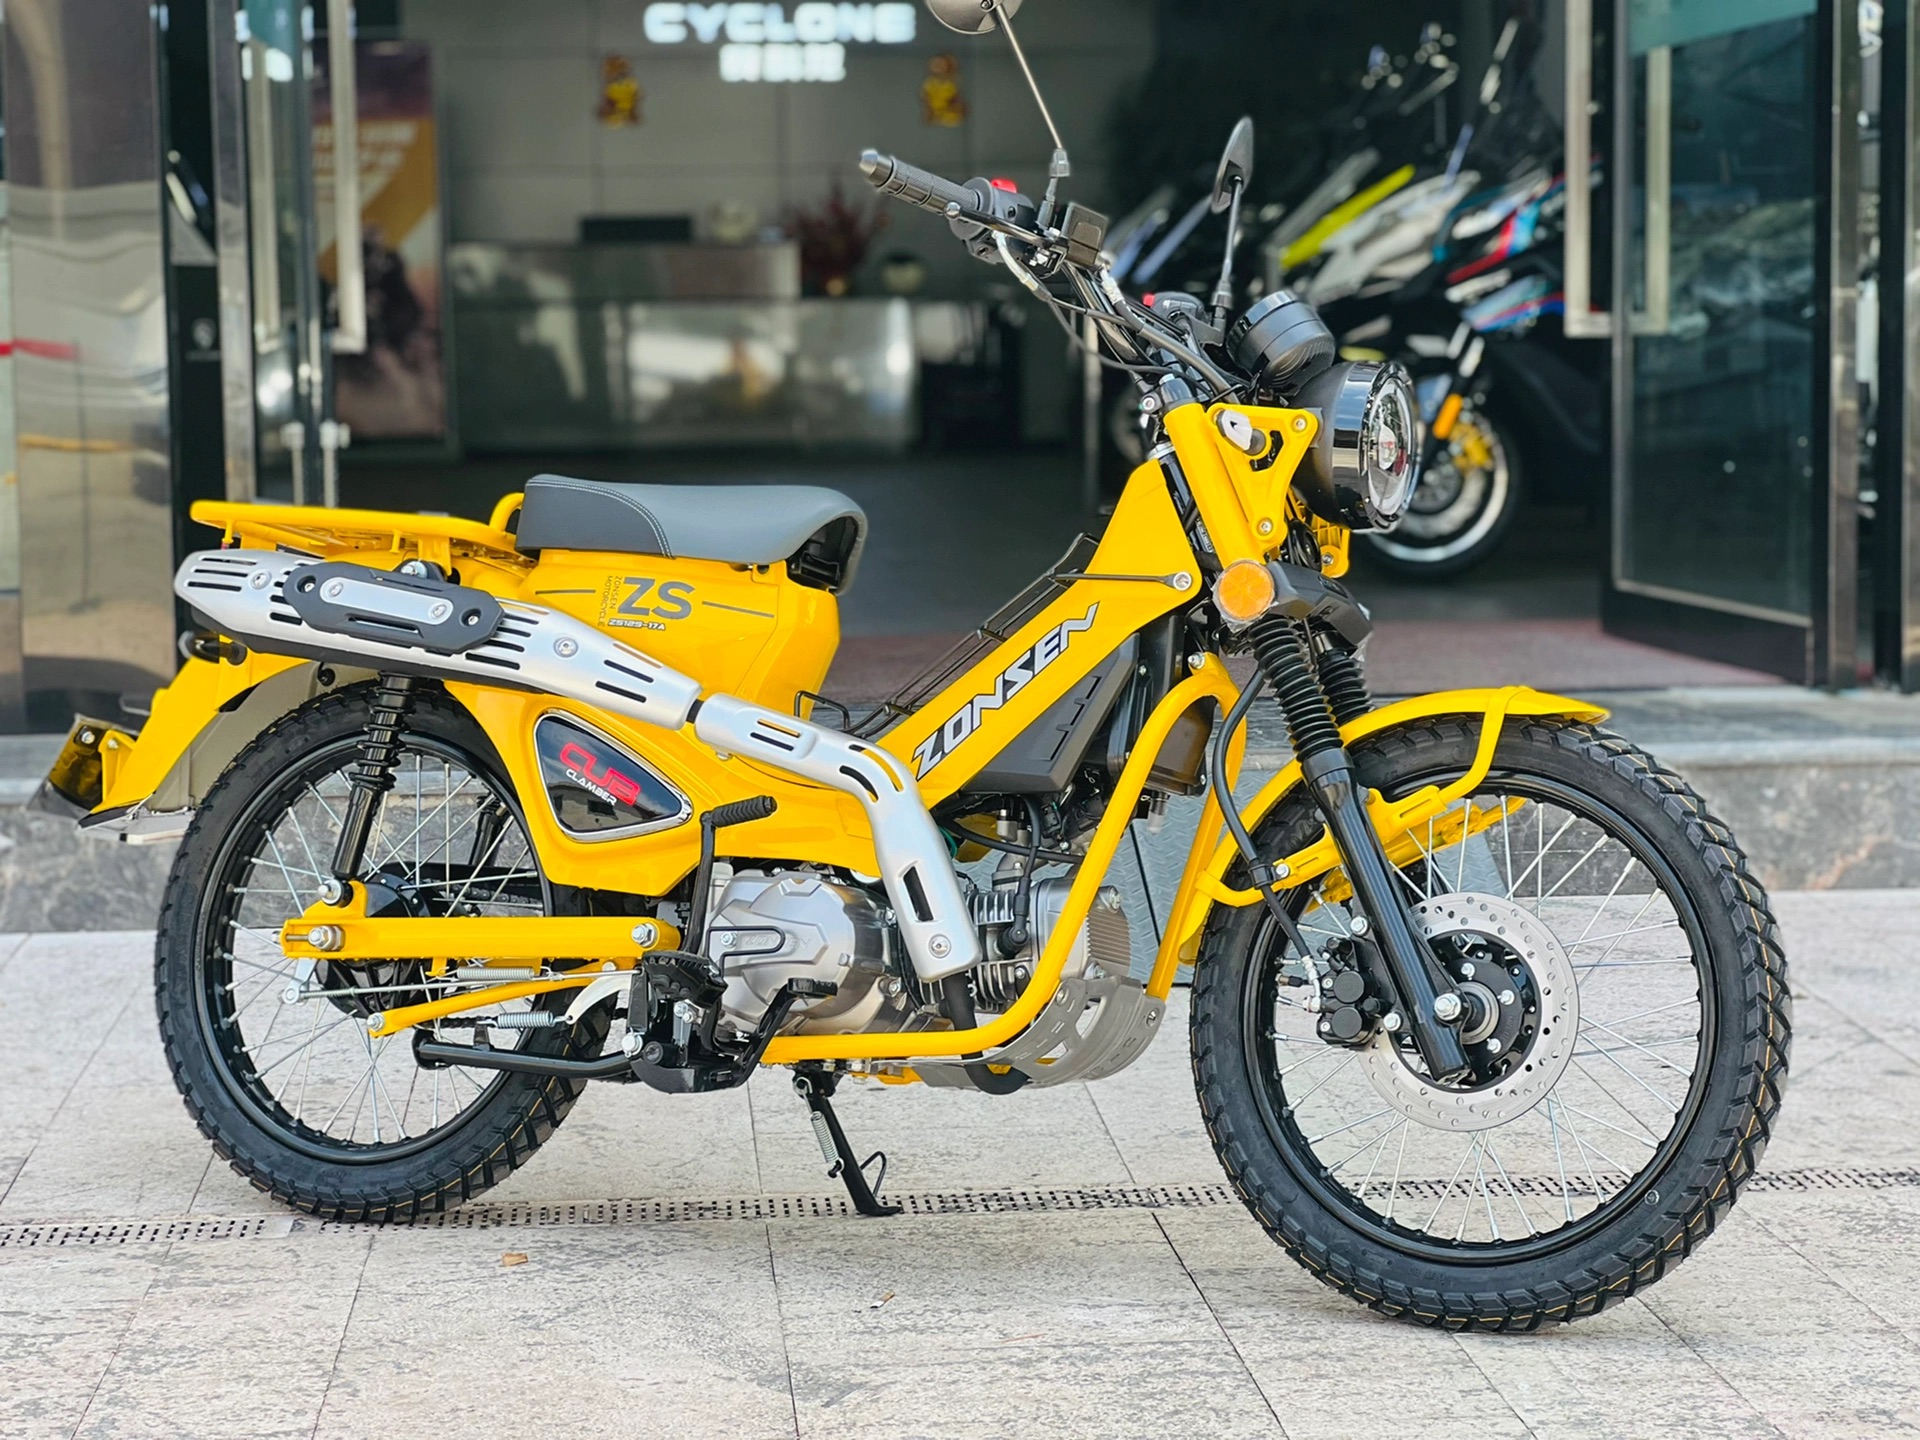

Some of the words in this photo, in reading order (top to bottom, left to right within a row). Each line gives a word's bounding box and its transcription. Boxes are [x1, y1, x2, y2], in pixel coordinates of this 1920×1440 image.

[644, 2, 914, 43] CYCLONE
[597, 575, 613, 627] MOTORCYCLE
[609, 576, 623, 610] ZONSEN
[617, 576, 696, 620] ZS
[607, 617, 666, 632] ZS125-17A
[911, 601, 1100, 782] ZONSEN
[559, 741, 642, 806] CUB
[565, 768, 618, 807] CLAMBER
